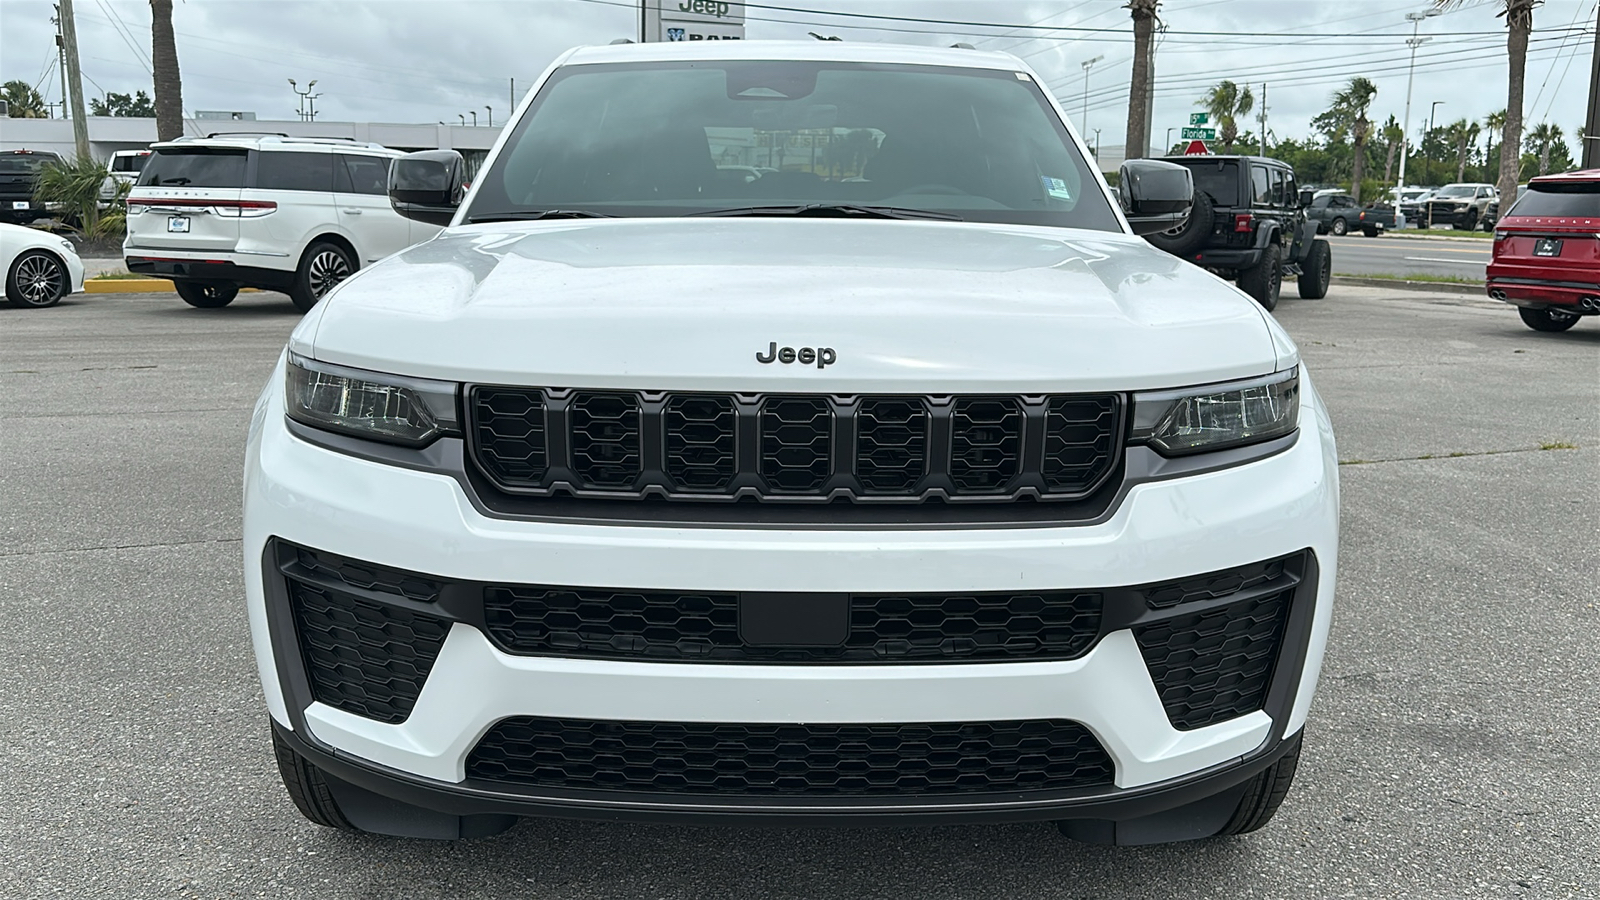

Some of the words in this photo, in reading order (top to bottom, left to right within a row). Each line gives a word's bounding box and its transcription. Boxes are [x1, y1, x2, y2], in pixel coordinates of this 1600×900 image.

[679, 0, 729, 18] Jeep
[1182, 129, 1206, 139] Florida
[759, 136, 826, 147] HUSE
[756, 342, 836, 369] Jeep
